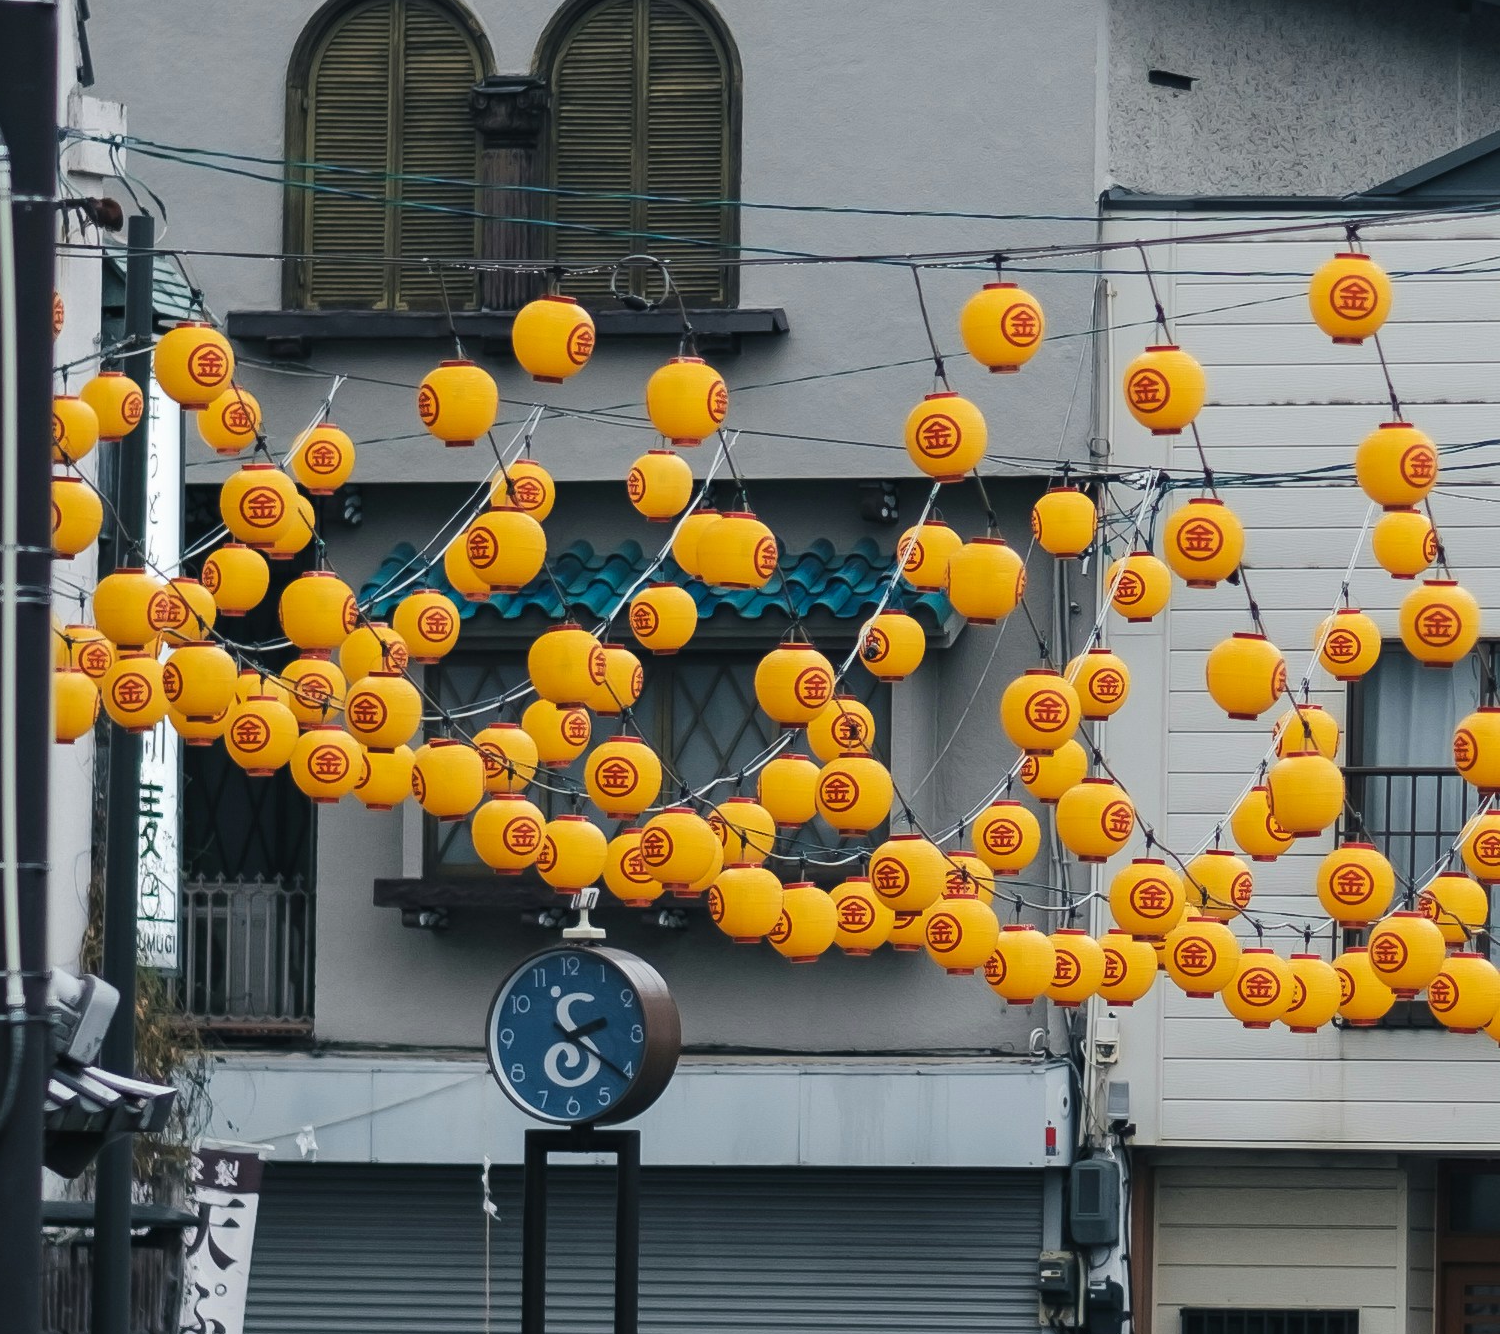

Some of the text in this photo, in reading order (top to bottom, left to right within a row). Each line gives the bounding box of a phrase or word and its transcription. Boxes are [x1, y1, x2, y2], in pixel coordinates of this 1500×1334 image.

[1339, 283, 1369, 311] 金
[1011, 312, 1034, 336] 金
[574, 333, 592, 356] 金
[198, 352, 222, 377] 金
[1134, 375, 1160, 404] 金
[230, 407, 253, 429] 金
[924, 423, 952, 447] 金
[311, 447, 336, 469] 金
[1410, 451, 1434, 478] 金
[518, 484, 539, 505] 金
[249, 496, 275, 519] 金
[470, 537, 491, 559] 金
[1186, 524, 1215, 550] 金
[1116, 576, 1140, 599] 金
[426, 613, 447, 633] 金
[634, 608, 654, 630] 金
[1423, 611, 1451, 638] 金
[1330, 635, 1355, 657] 金
[87, 648, 109, 673] 金
[119, 681, 144, 704] 金
[302, 680, 327, 701] 金
[803, 674, 827, 698] 金
[1097, 674, 1121, 698] 金
[354, 700, 378, 722] 金
[1034, 697, 1062, 722] 金
[239, 722, 262, 743] 金
[569, 716, 587, 739] 金
[317, 753, 341, 773] 金
[603, 763, 631, 786] 金
[825, 778, 852, 802] 金
[1109, 806, 1131, 836] 金
[512, 824, 534, 845] 金
[995, 825, 1017, 846] 金
[644, 835, 667, 858] 金
[1480, 838, 1500, 860] 金
[876, 864, 900, 888] 金
[1338, 873, 1365, 896] 金
[1139, 887, 1164, 909] 金
[842, 901, 868, 924] 金
[931, 919, 954, 943] 金
[1183, 944, 1207, 967] 金
[1375, 941, 1402, 965] 金
[533, 969, 546, 987] 11
[560, 957, 580, 976] 12
[600, 965, 606, 983] 1
[620, 989, 634, 1007] 2
[1247, 974, 1275, 999] 金
[511, 995, 530, 1013] 10
[501, 1029, 514, 1049] 9
[631, 1025, 643, 1043] 3
[512, 1063, 525, 1082] 8
[623, 1061, 634, 1079] 4
[538, 1090, 548, 1108] 7
[567, 1097, 580, 1116] 6
[598, 1087, 611, 1105] 5
